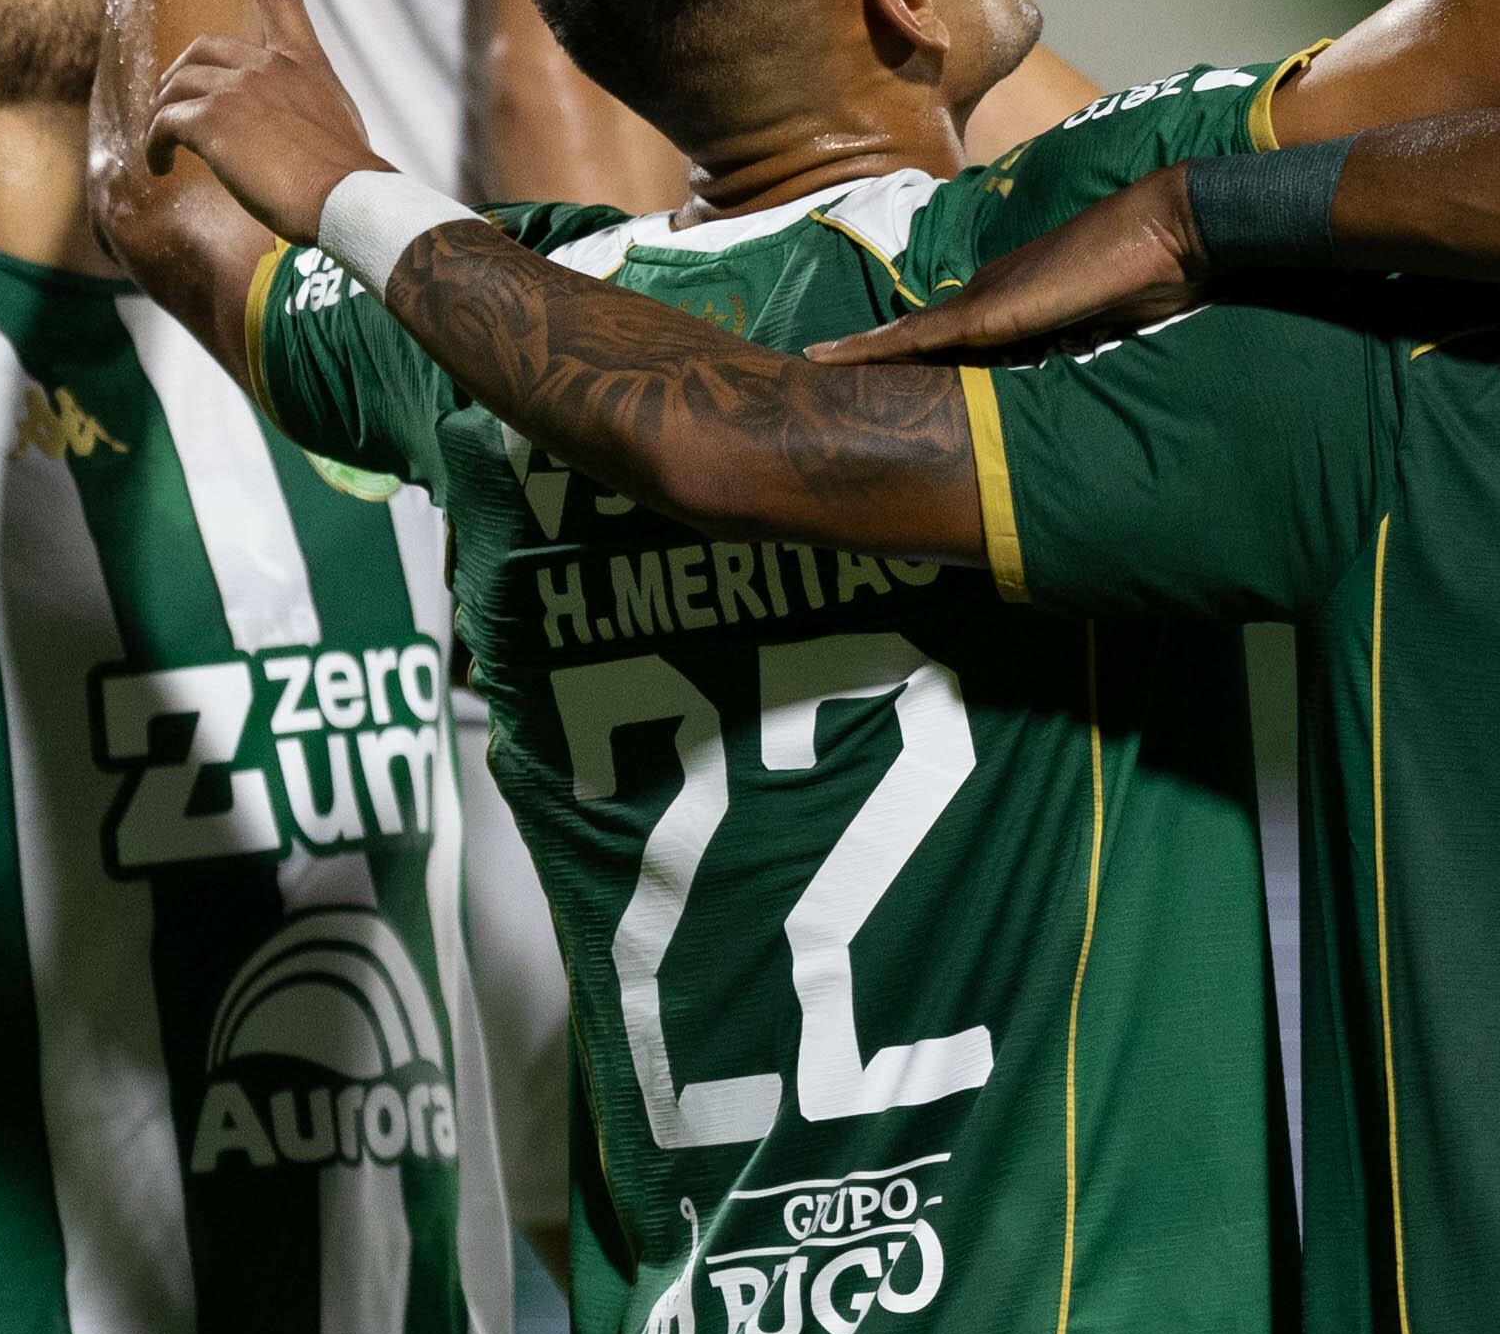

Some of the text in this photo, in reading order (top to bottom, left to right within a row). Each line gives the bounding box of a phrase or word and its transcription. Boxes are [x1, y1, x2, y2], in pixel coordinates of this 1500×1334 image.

[262, 642, 442, 735] zero
[550, 631, 996, 1149] 22
[189, 1080, 458, 1173] Aurora
